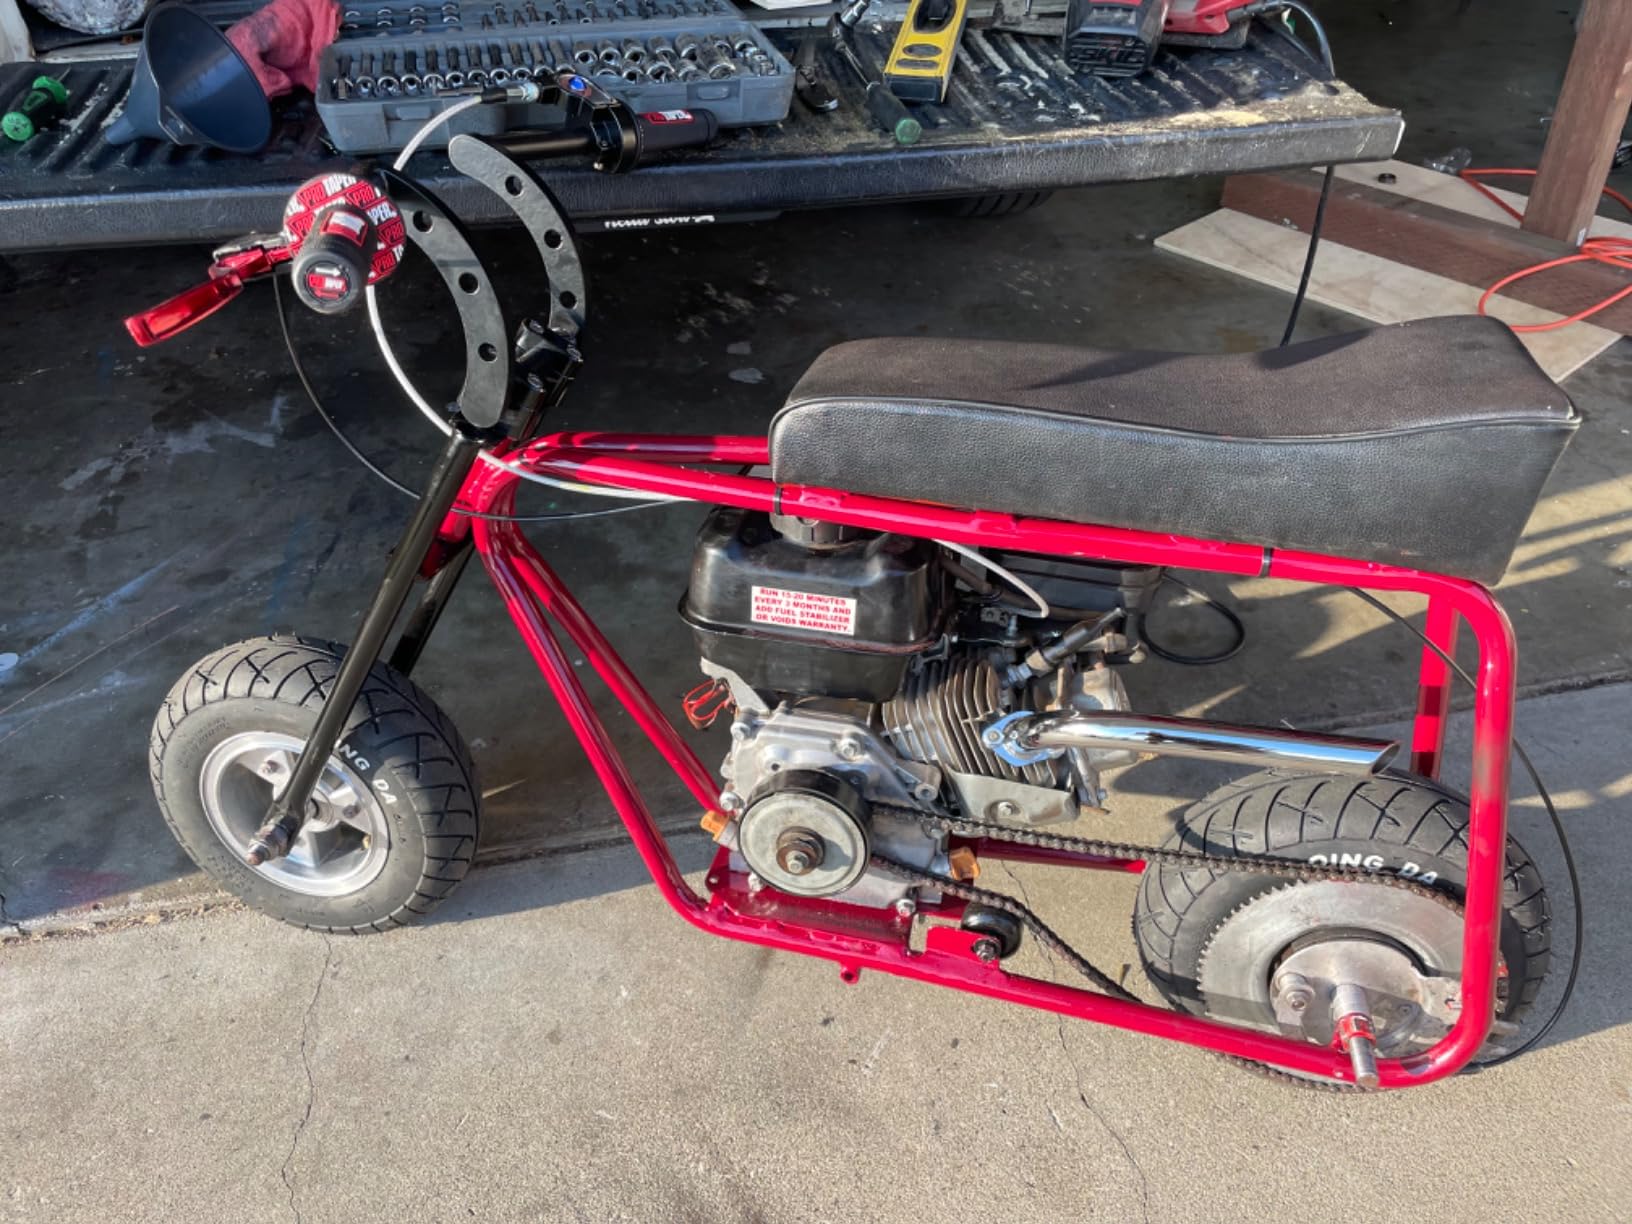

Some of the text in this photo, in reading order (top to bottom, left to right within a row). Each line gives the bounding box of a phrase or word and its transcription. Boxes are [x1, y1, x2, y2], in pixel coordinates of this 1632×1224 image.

[760, 587, 778, 596] RUN
[806, 594, 846, 605] MINUTES
[755, 596, 782, 604] EVERY
[793, 601, 830, 612] MONTHS
[832, 607, 851, 615] AND
[755, 605, 849, 623] ADD FUEL STABILIZER
[756, 613, 768, 621] OR
[771, 615, 796, 624] VOIDS
[372, 779, 397, 804] DA
[1398, 861, 1439, 885] DA
